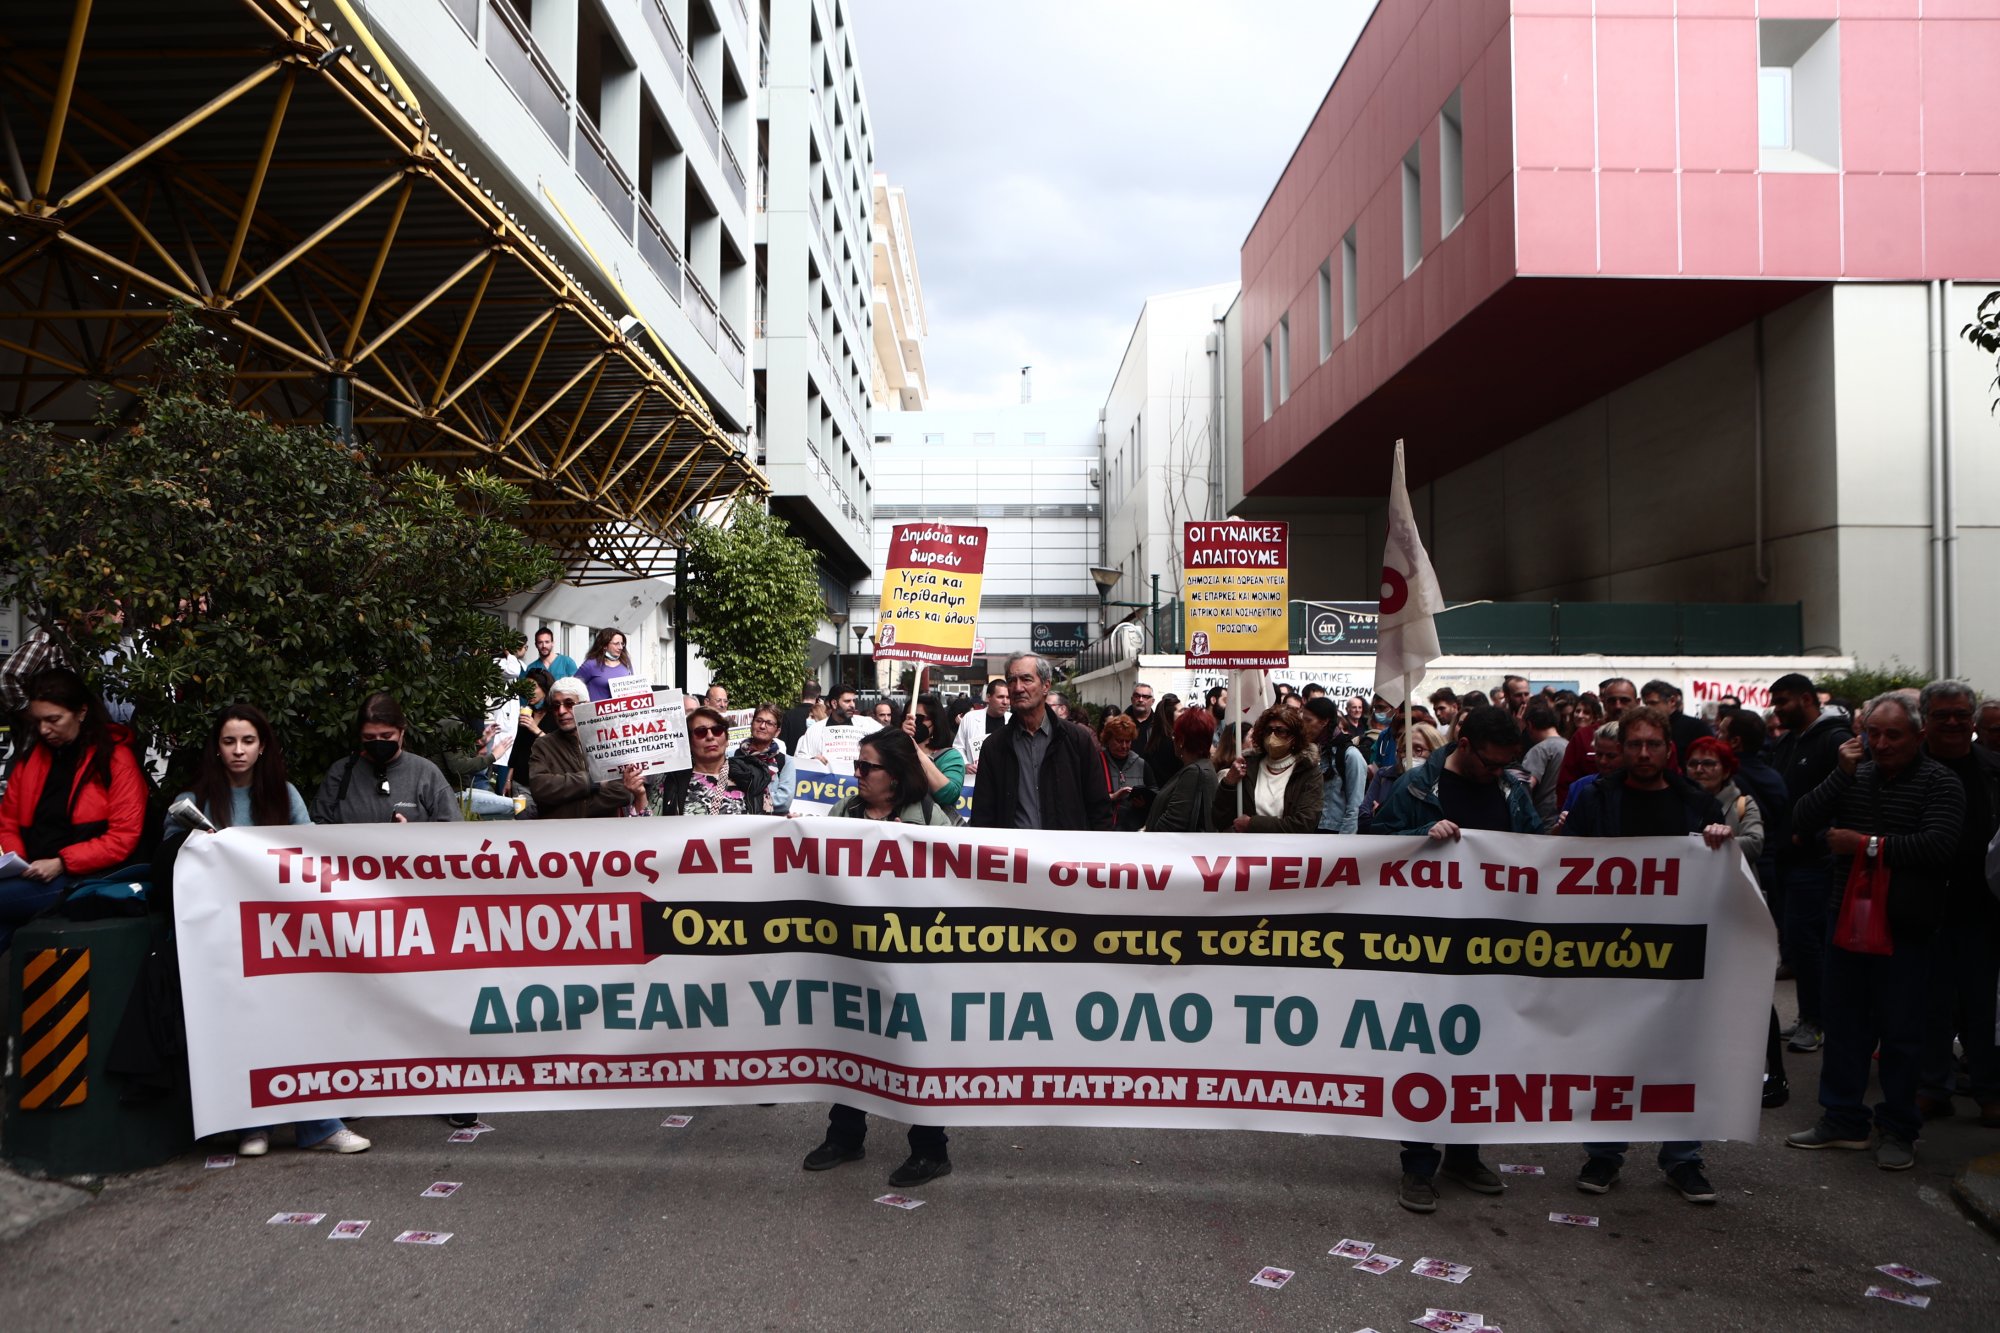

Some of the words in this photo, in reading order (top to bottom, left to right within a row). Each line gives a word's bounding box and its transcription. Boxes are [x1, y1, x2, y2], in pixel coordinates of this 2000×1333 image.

[900, 528, 953, 544] Δημόσια
[958, 534, 979, 546] και
[1189, 527, 1205, 542] ΟΙ
[1211, 526, 1282, 542] ΓΥΝΑΙΚΕΣ
[910, 548, 962, 566] δωρεάν
[1192, 549, 1279, 565] ΑΠΑΙΤΟΥΜΕ
[901, 570, 936, 587] Υγεία
[942, 577, 963, 588] και
[1187, 576, 1220, 585] ΔΗΜΟΣΙΑ
[1222, 576, 1235, 584] ΚΑΙ
[1237, 576, 1264, 585] ΔΩΡΕΑΝ
[1266, 576, 1285, 585] ΥΓΕΙΑ
[893, 587, 965, 608] Περίθαλψη
[1191, 592, 1201, 601] ΜΕ
[1204, 592, 1236, 601] ΕΠΑΡΚΕΣ
[1238, 592, 1250, 601] ΚΑΙ
[1252, 592, 1281, 601] ΜΟΝΙΜΟ
[880, 610, 892, 622] για
[896, 607, 920, 619] όλες
[924, 611, 940, 622] και
[944, 611, 975, 625] όλους
[1190, 608, 1218, 617] ΙΑΤΡΙΚΟ
[1220, 608, 1232, 617] ΚΑΙ
[1235, 608, 1282, 617] ΝΟΣΗΛΕΥΤΙΚΟ
[1216, 624, 1258, 633] ΠΡΟΣΩΠΙΚΟ
[911, 650, 942, 660] ΓΥΝΑΙΚΩΝ
[943, 654, 969, 662] ΕΛΛΑΔΑΣ
[1188, 658, 1227, 666] ΟΜΟΣΠΟΝΔΙΑ
[1229, 658, 1258, 666] ΓΥΝΑΙΚΩΝ
[1259, 657, 1287, 665] ΕΛΛΑΔΑΣ
[1274, 670, 1296, 680] ΣΤΙΣ
[1300, 671, 1353, 683] ΠΟΛΙΤΙΚΕΣ
[598, 700, 628, 714] ΛΕΜΕ
[630, 697, 653, 709] ΟΧΙ
[618, 711, 638, 719] νόμιμο
[651, 705, 682, 714] παράνομο
[596, 727, 619, 742] ΓΙΑ
[622, 719, 667, 738] ΕΜΑΣ
[618, 739, 637, 747] ΥΓΕΙΑ
[638, 732, 684, 743] ΕΜΠΟΡΕΥΜΑ
[610, 747, 640, 757] ΑΣΘΕΝΗΣ
[641, 742, 674, 752] ΠΕΛΑΤΗΣ
[266, 839, 660, 893] Τιμοκατάλογος
[677, 838, 753, 875] ΔΕ
[773, 837, 1029, 884] ΜΠΑΙΝΕΙ
[1048, 860, 1174, 891] στην
[1191, 856, 1361, 893] ΥΓΕΙΑ
[1379, 858, 1463, 889] και
[1480, 862, 1539, 895] τη
[1556, 857, 1681, 896] ΖΩΗ
[257, 908, 436, 960] ΚΑΜΙΑ
[450, 904, 633, 954] ΑΝΟΧΗ
[661, 906, 748, 946] Όχι
[763, 916, 838, 946] στο
[852, 911, 1078, 953] πλιάτσικο
[1093, 929, 1183, 965] στις
[1197, 918, 1345, 968] τσέπες
[1359, 932, 1452, 964] των
[1466, 927, 1674, 969] ασθενών
[469, 982, 729, 1035] ΔΩΡΕΑΝ
[748, 979, 928, 1042] ΥΓΕΙΑ
[950, 992, 1054, 1042] ΓΙΑ
[1075, 991, 1213, 1043] ΟΛΟ
[1234, 995, 1319, 1046] ΤΟ
[1340, 999, 1481, 1056] ΛΑΟ
[268, 1062, 525, 1099] ΟΜΟΣΠΟΝΔΙΑ
[532, 1059, 704, 1085] ΕΝΩΣΕΩΝ
[714, 1055, 1024, 1100] ΝΟΣΟΚΟΜΕΙΑΚΩΝ
[1032, 1075, 1188, 1100] ΓΙΑΤΡΩΝ
[1197, 1077, 1366, 1108] ΕΛΛΑΔΑΣ
[1391, 1072, 1635, 1123] ΟΕΝΓΕ
